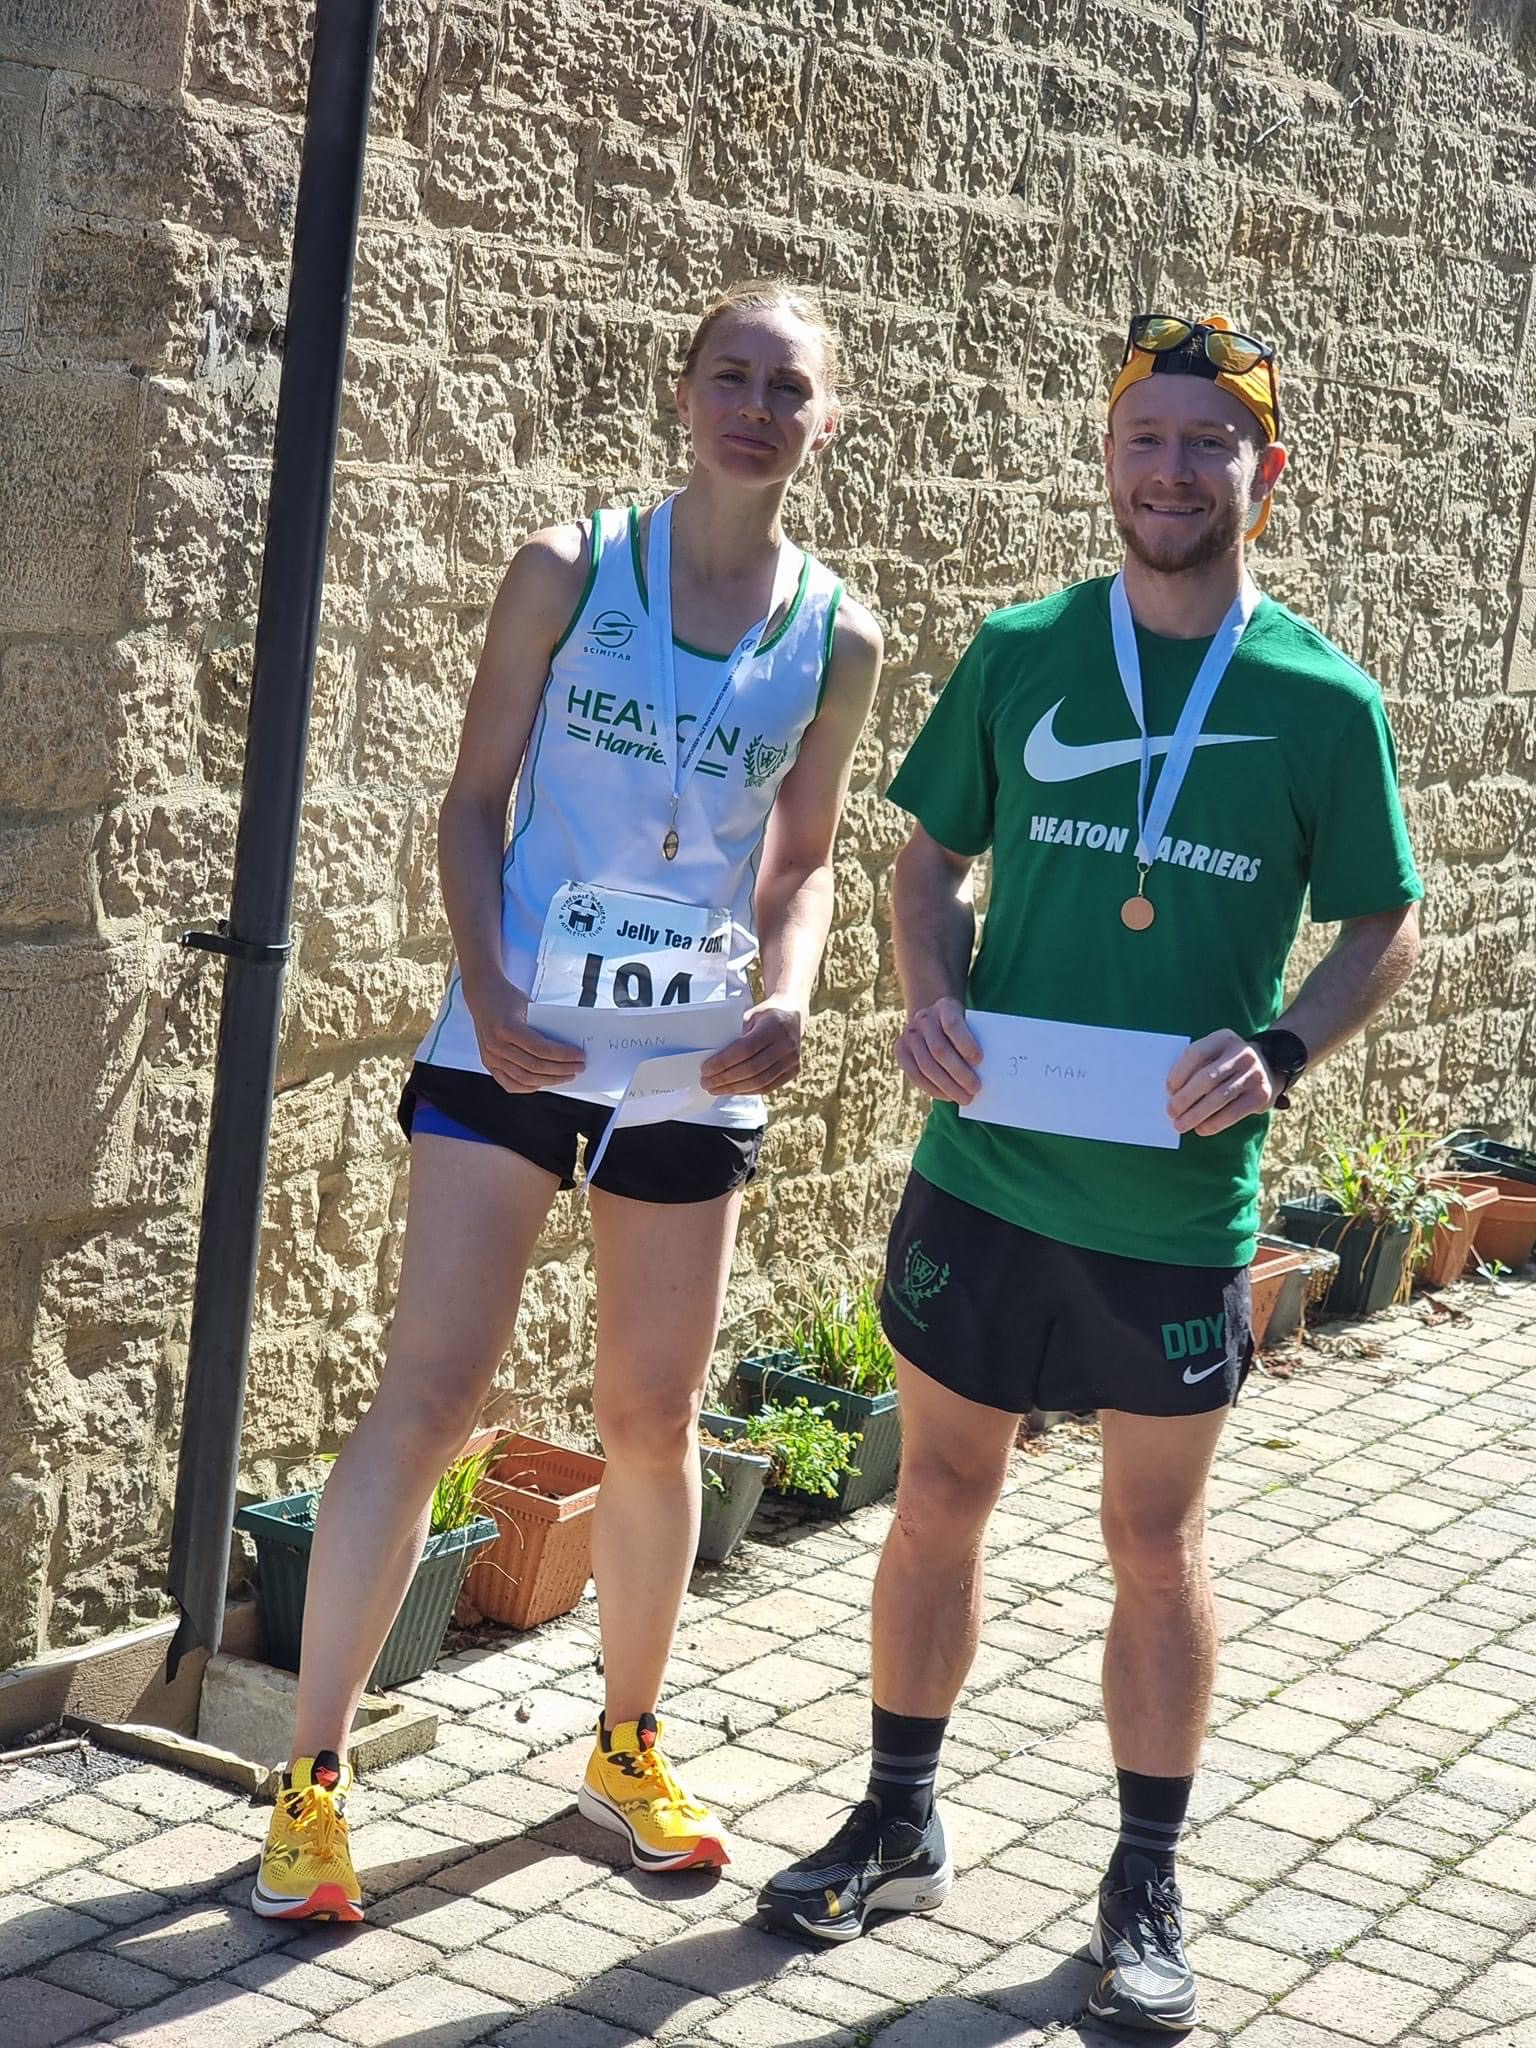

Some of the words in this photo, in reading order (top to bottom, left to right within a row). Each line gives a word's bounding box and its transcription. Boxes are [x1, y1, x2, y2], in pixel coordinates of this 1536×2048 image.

[583, 646, 631, 661] SCIMITAR
[594, 729, 667, 766] Harrie
[1029, 815, 1129, 854] HEATON
[1134, 836, 1262, 883] ARRIERS
[560, 922, 587, 938] ATHLETIC
[588, 926, 603, 938] CLUB
[616, 919, 660, 945] Jelly
[664, 929, 693, 950] Tea
[608, 1036, 666, 1050] WOMAN
[1044, 1063, 1087, 1079] MAN
[1160, 1311, 1226, 1361] DDY
